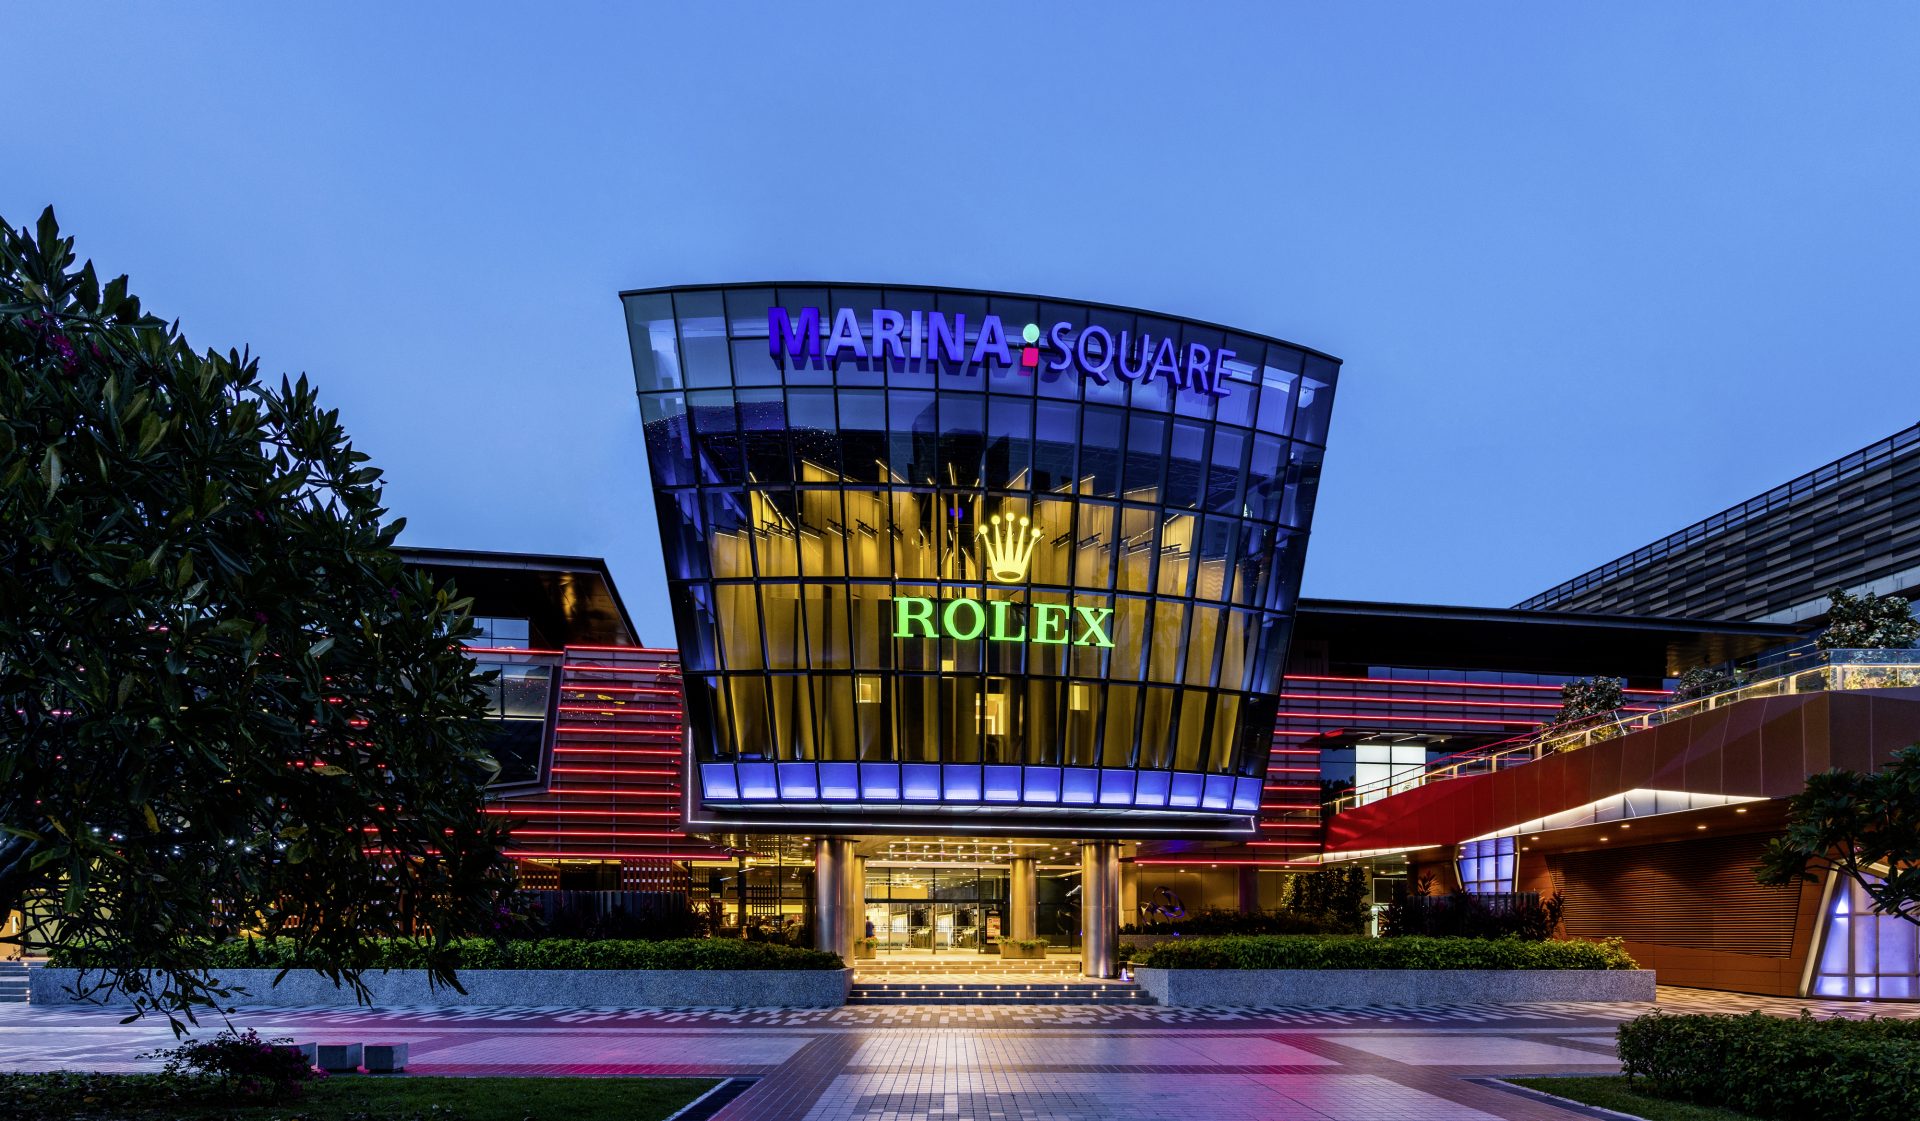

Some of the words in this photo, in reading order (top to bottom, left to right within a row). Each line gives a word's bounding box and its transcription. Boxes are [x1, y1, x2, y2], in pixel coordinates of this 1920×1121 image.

[768, 306, 1012, 364] MARINA
[1048, 321, 1237, 396] SQUARE
[893, 596, 1115, 647] ROLEX
